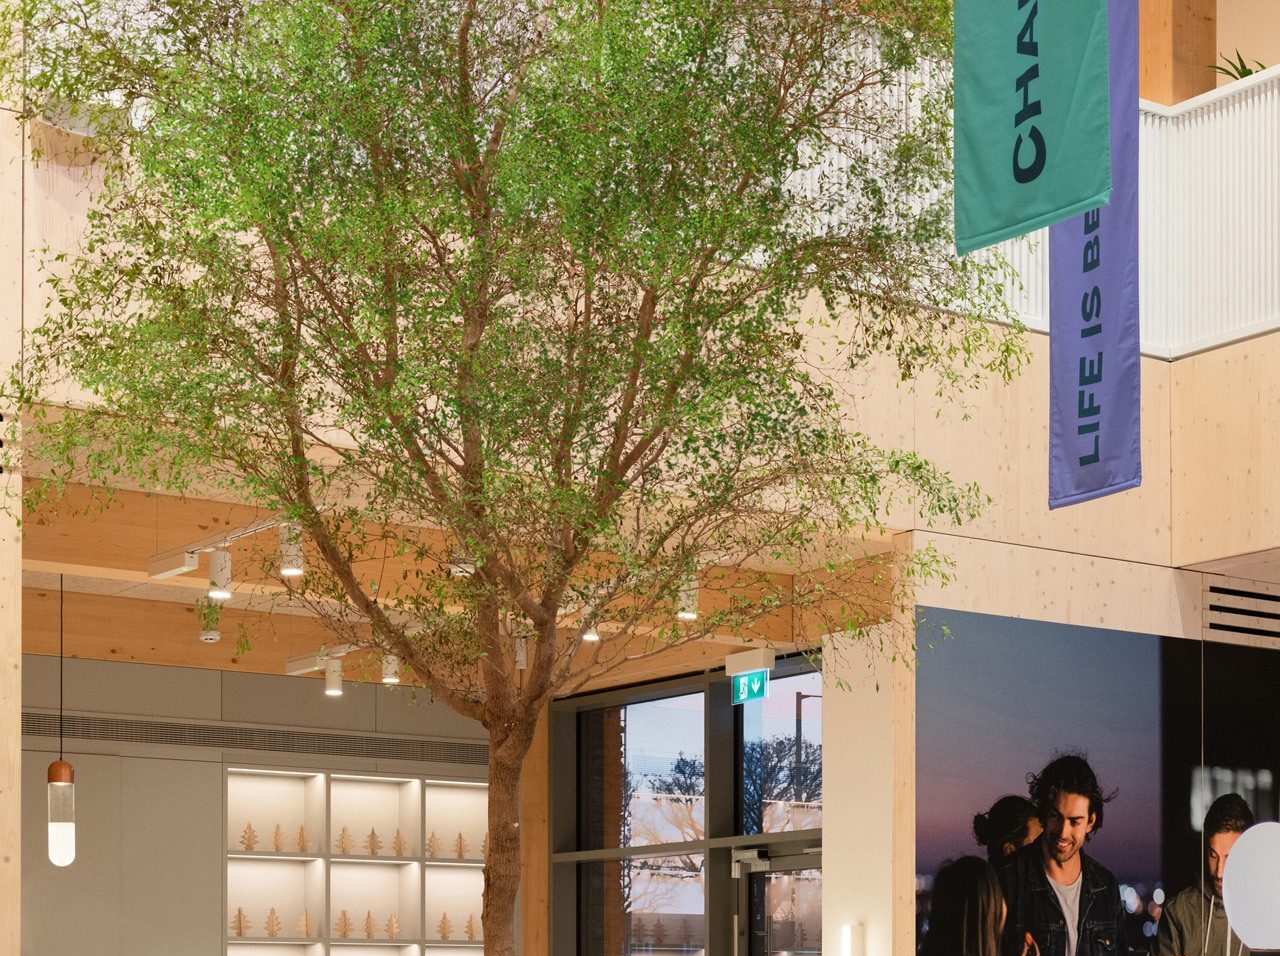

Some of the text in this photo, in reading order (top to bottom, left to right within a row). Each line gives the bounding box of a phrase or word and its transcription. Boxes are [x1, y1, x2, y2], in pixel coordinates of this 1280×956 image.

[1013, 0, 1046, 184] CHA
[1080, 285, 1102, 338] IS
[1077, 351, 1103, 467] LIFE
